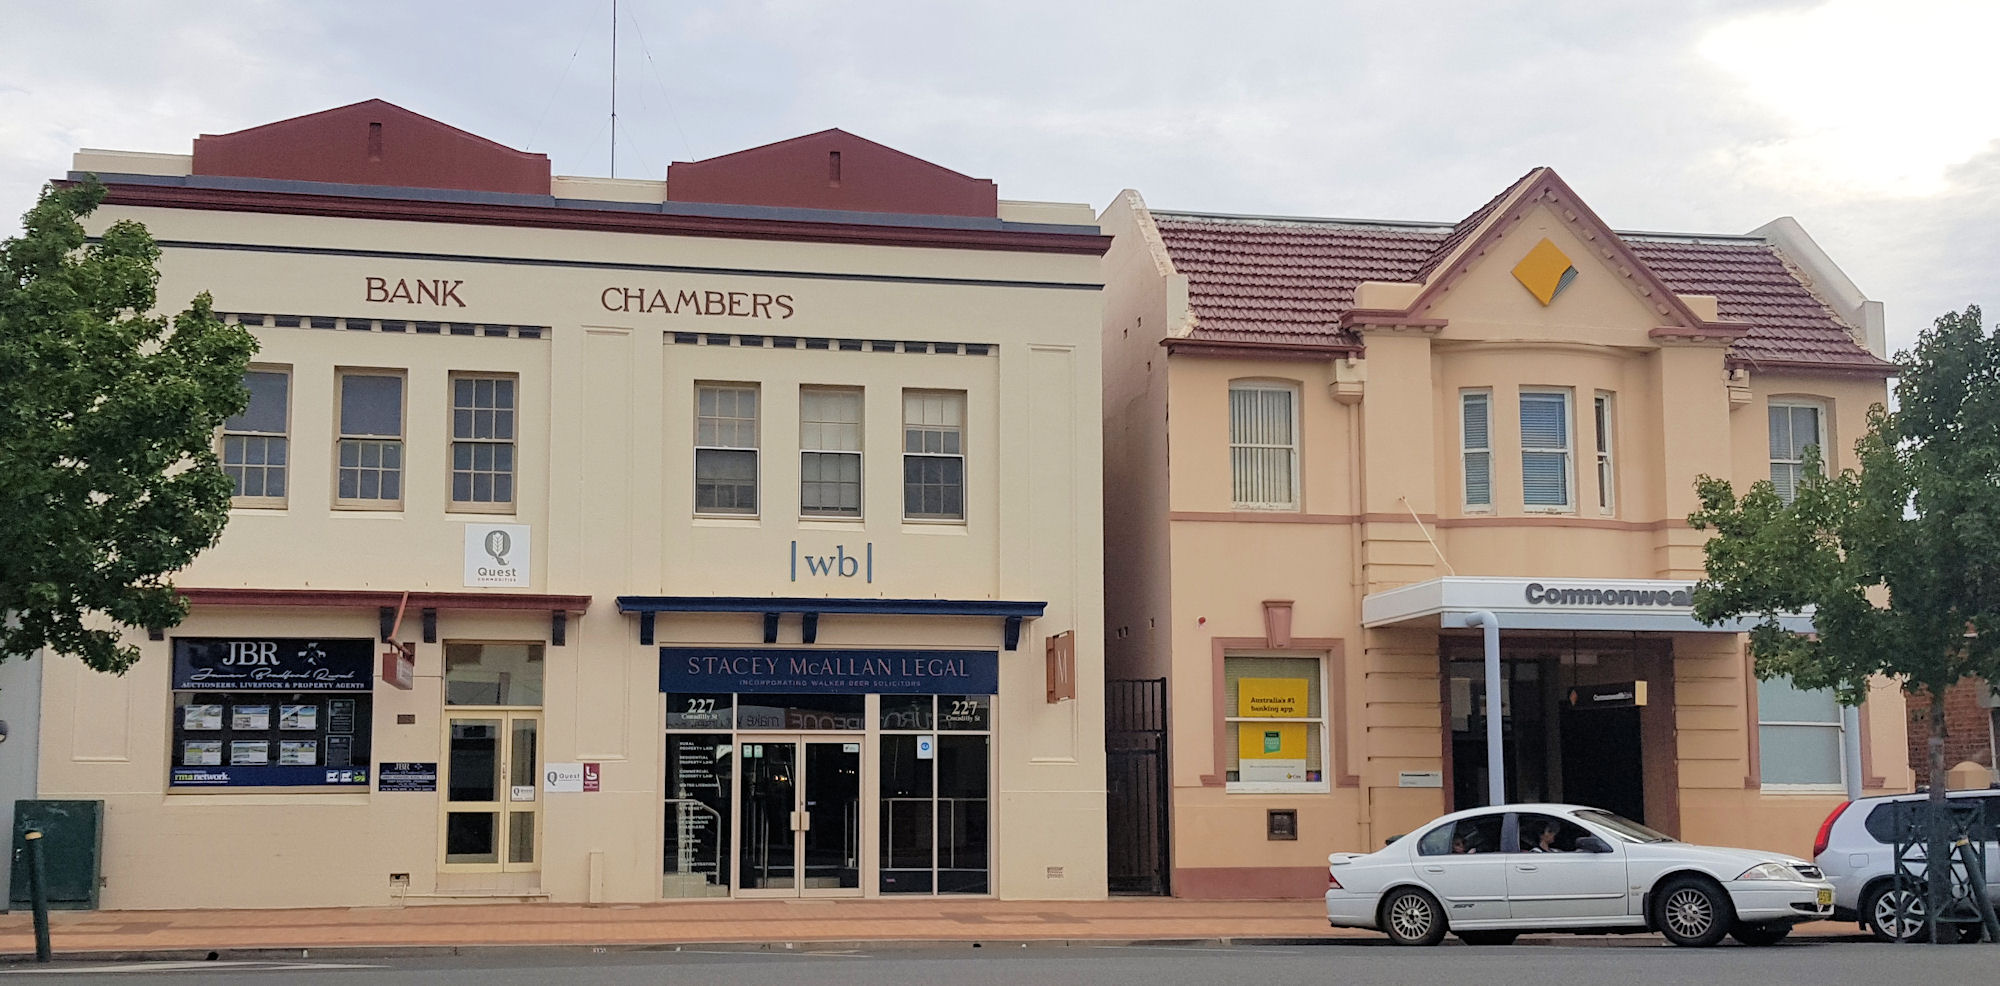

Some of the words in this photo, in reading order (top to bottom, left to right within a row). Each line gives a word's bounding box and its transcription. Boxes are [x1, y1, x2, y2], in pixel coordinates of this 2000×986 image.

[366, 277, 466, 308] BANK
[601, 287, 794, 319] CHAMBERS
[477, 567, 516, 577] Quest
[1526, 583, 1694, 606] Commonweal
[222, 641, 280, 665] JBR
[688, 657, 778, 675] STACEY
[790, 658, 892, 676] McALLAN
[902, 659, 970, 677] LEGAL
[688, 699, 715, 713] 227
[952, 701, 978, 715] 227
